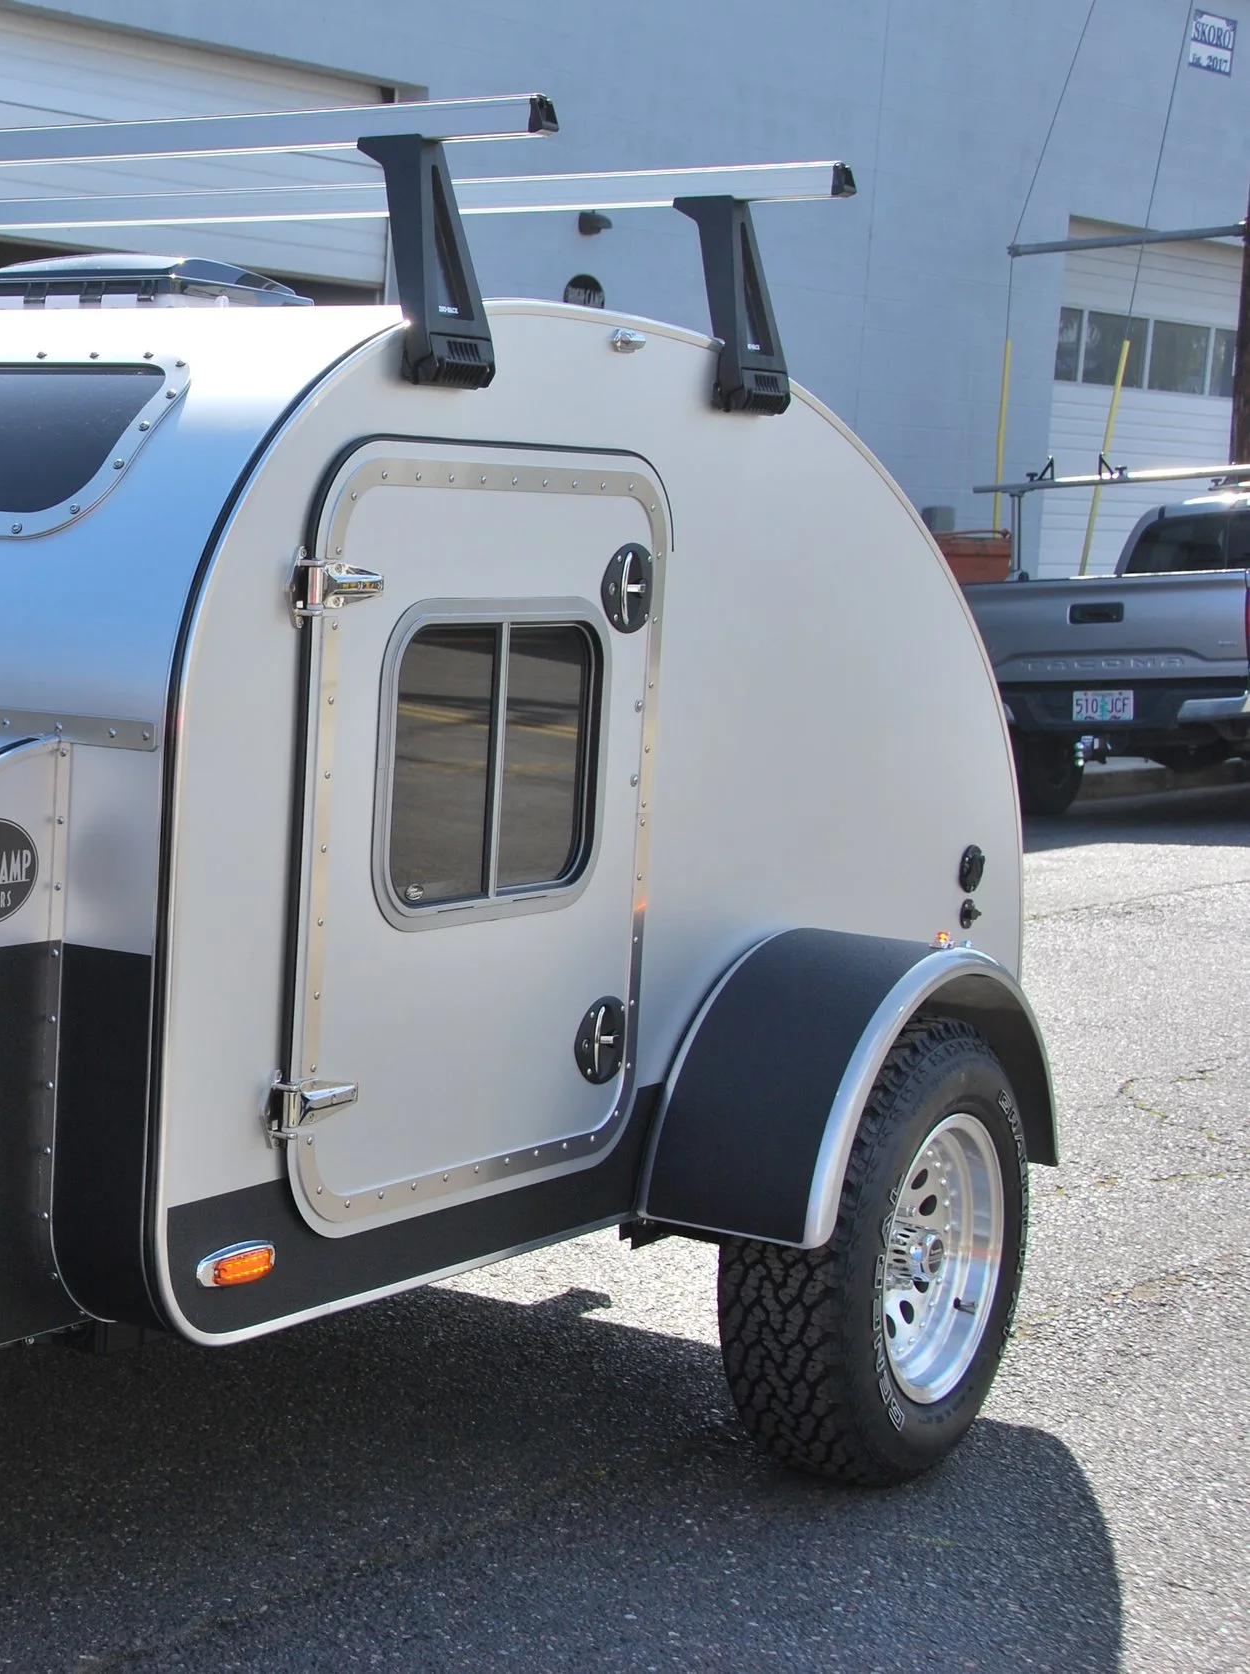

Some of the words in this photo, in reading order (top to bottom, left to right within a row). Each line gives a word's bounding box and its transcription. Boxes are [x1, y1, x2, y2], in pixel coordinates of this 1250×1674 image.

[1193, 21, 1232, 48] SKORO
[1206, 55, 1229, 73] 2017
[1020, 655, 1186, 672] TACOMA
[1075, 698, 1099, 714] 510
[1107, 697, 1130, 714] JCF
